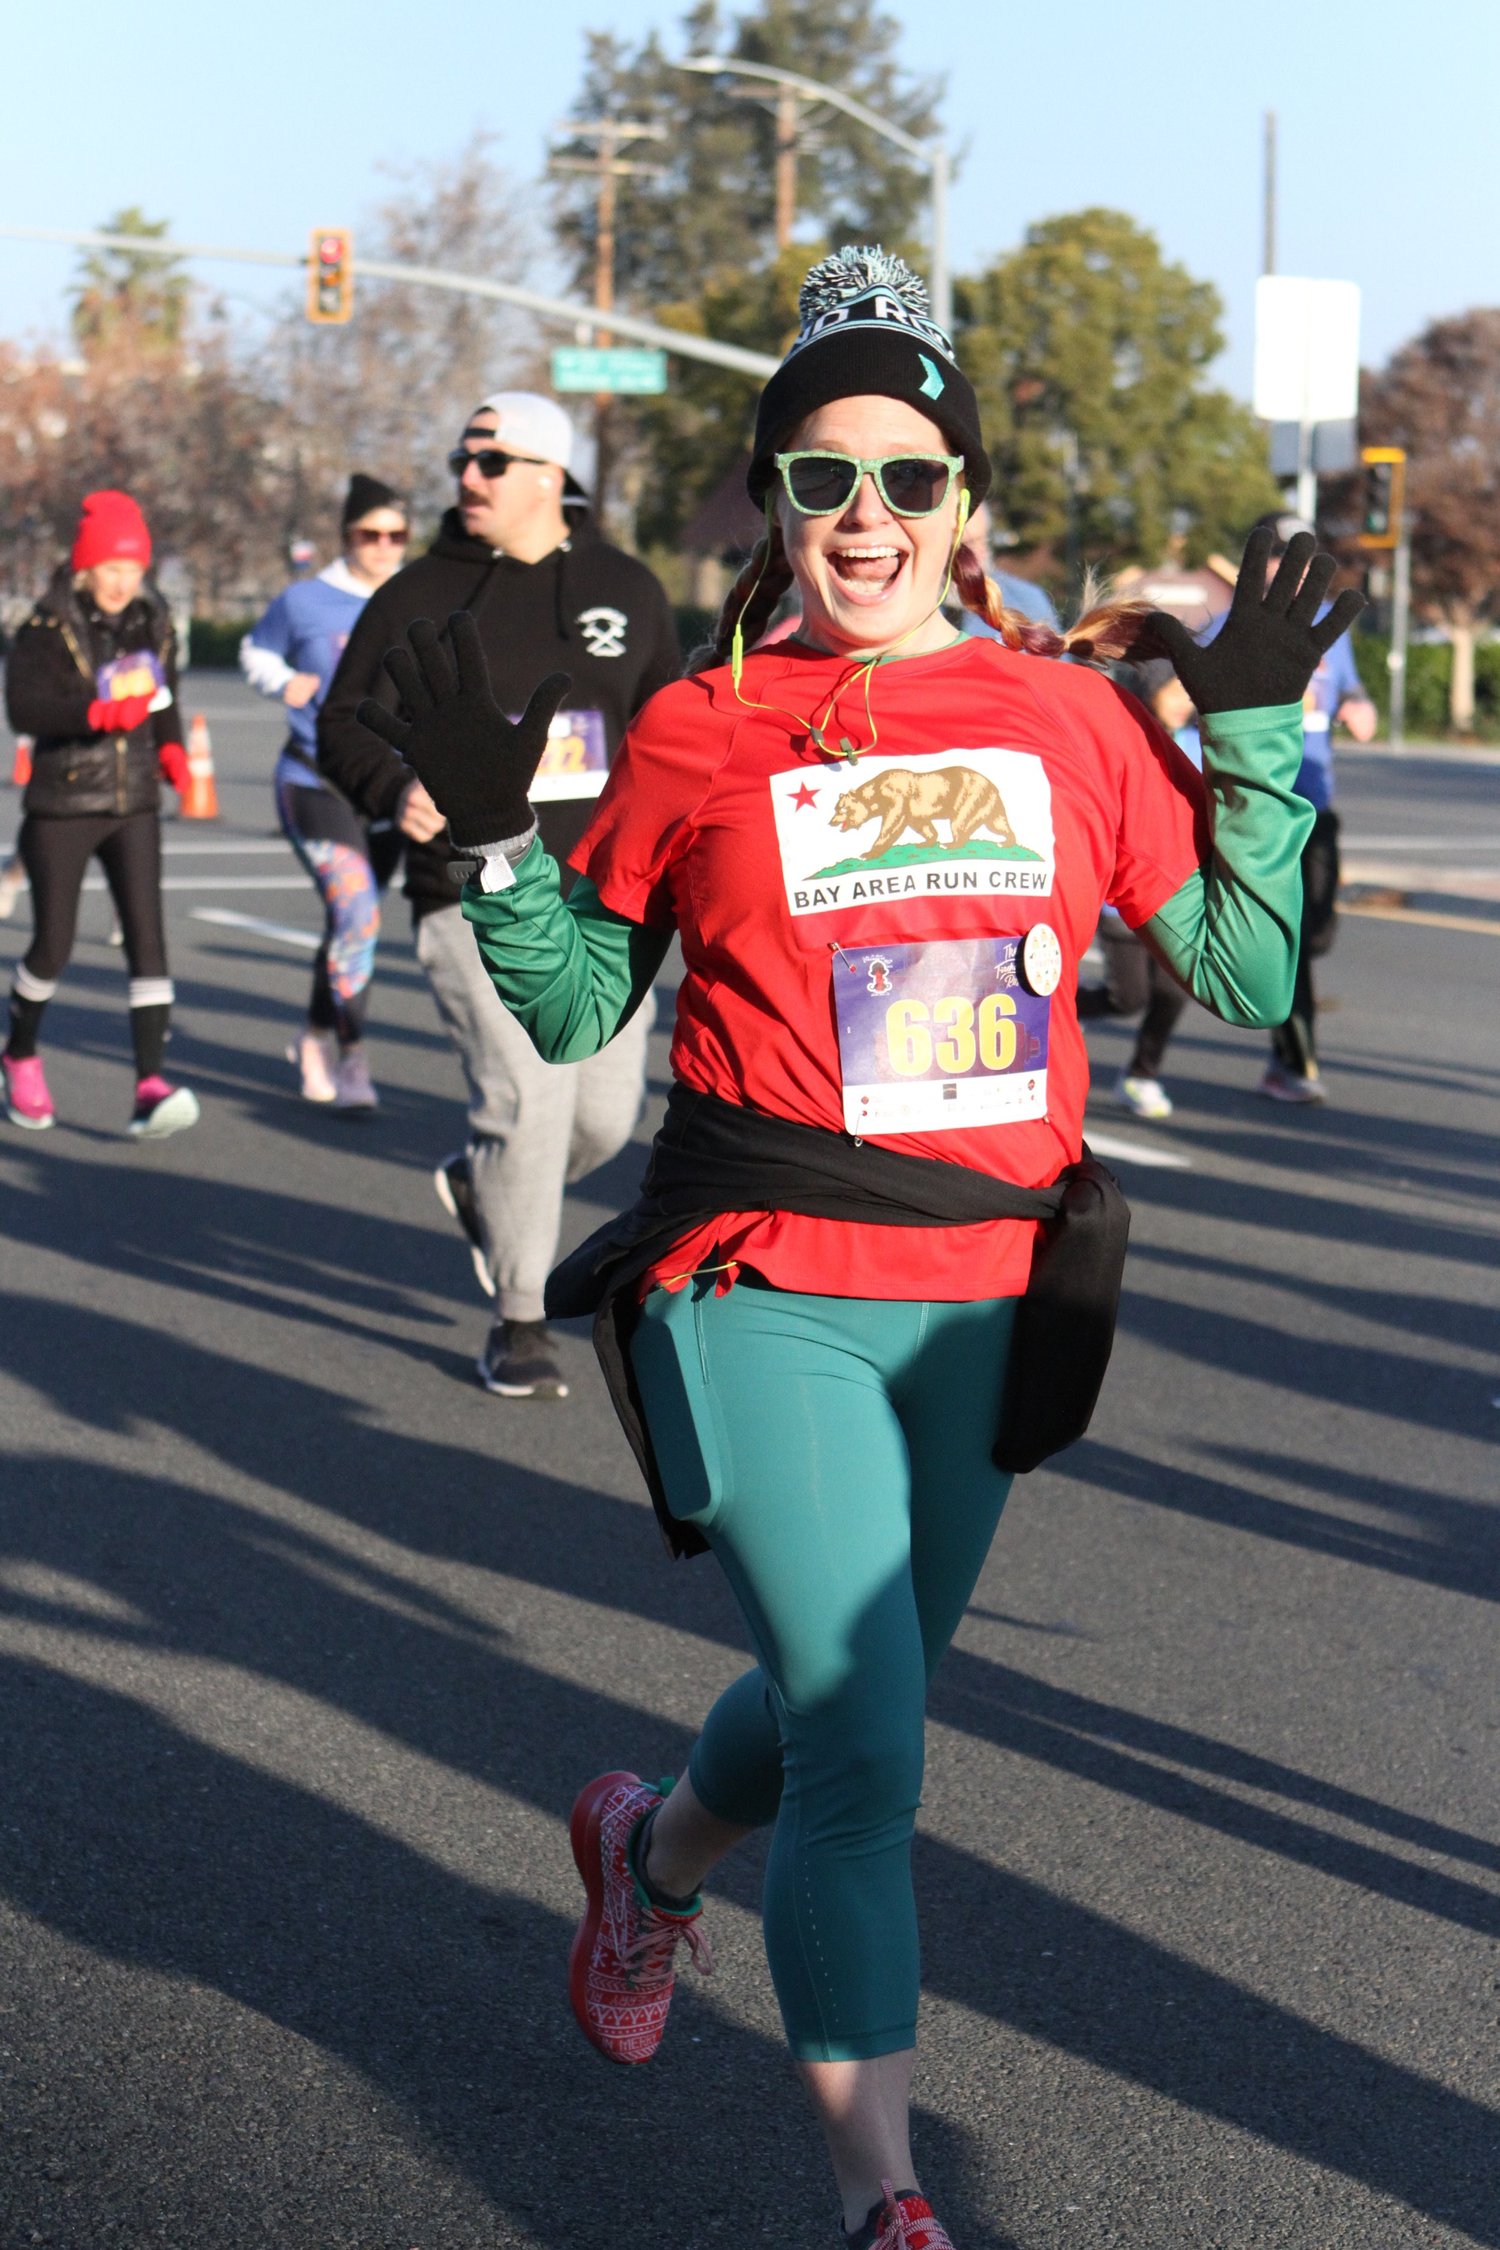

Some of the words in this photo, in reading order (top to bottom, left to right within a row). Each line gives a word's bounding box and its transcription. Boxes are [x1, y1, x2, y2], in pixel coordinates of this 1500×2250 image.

[794, 885, 841, 909] BAY
[852, 875, 917, 900] AREA
[926, 871, 978, 890] RUN
[988, 871, 1047, 890] CREW
[885, 993, 1017, 1077] 636
